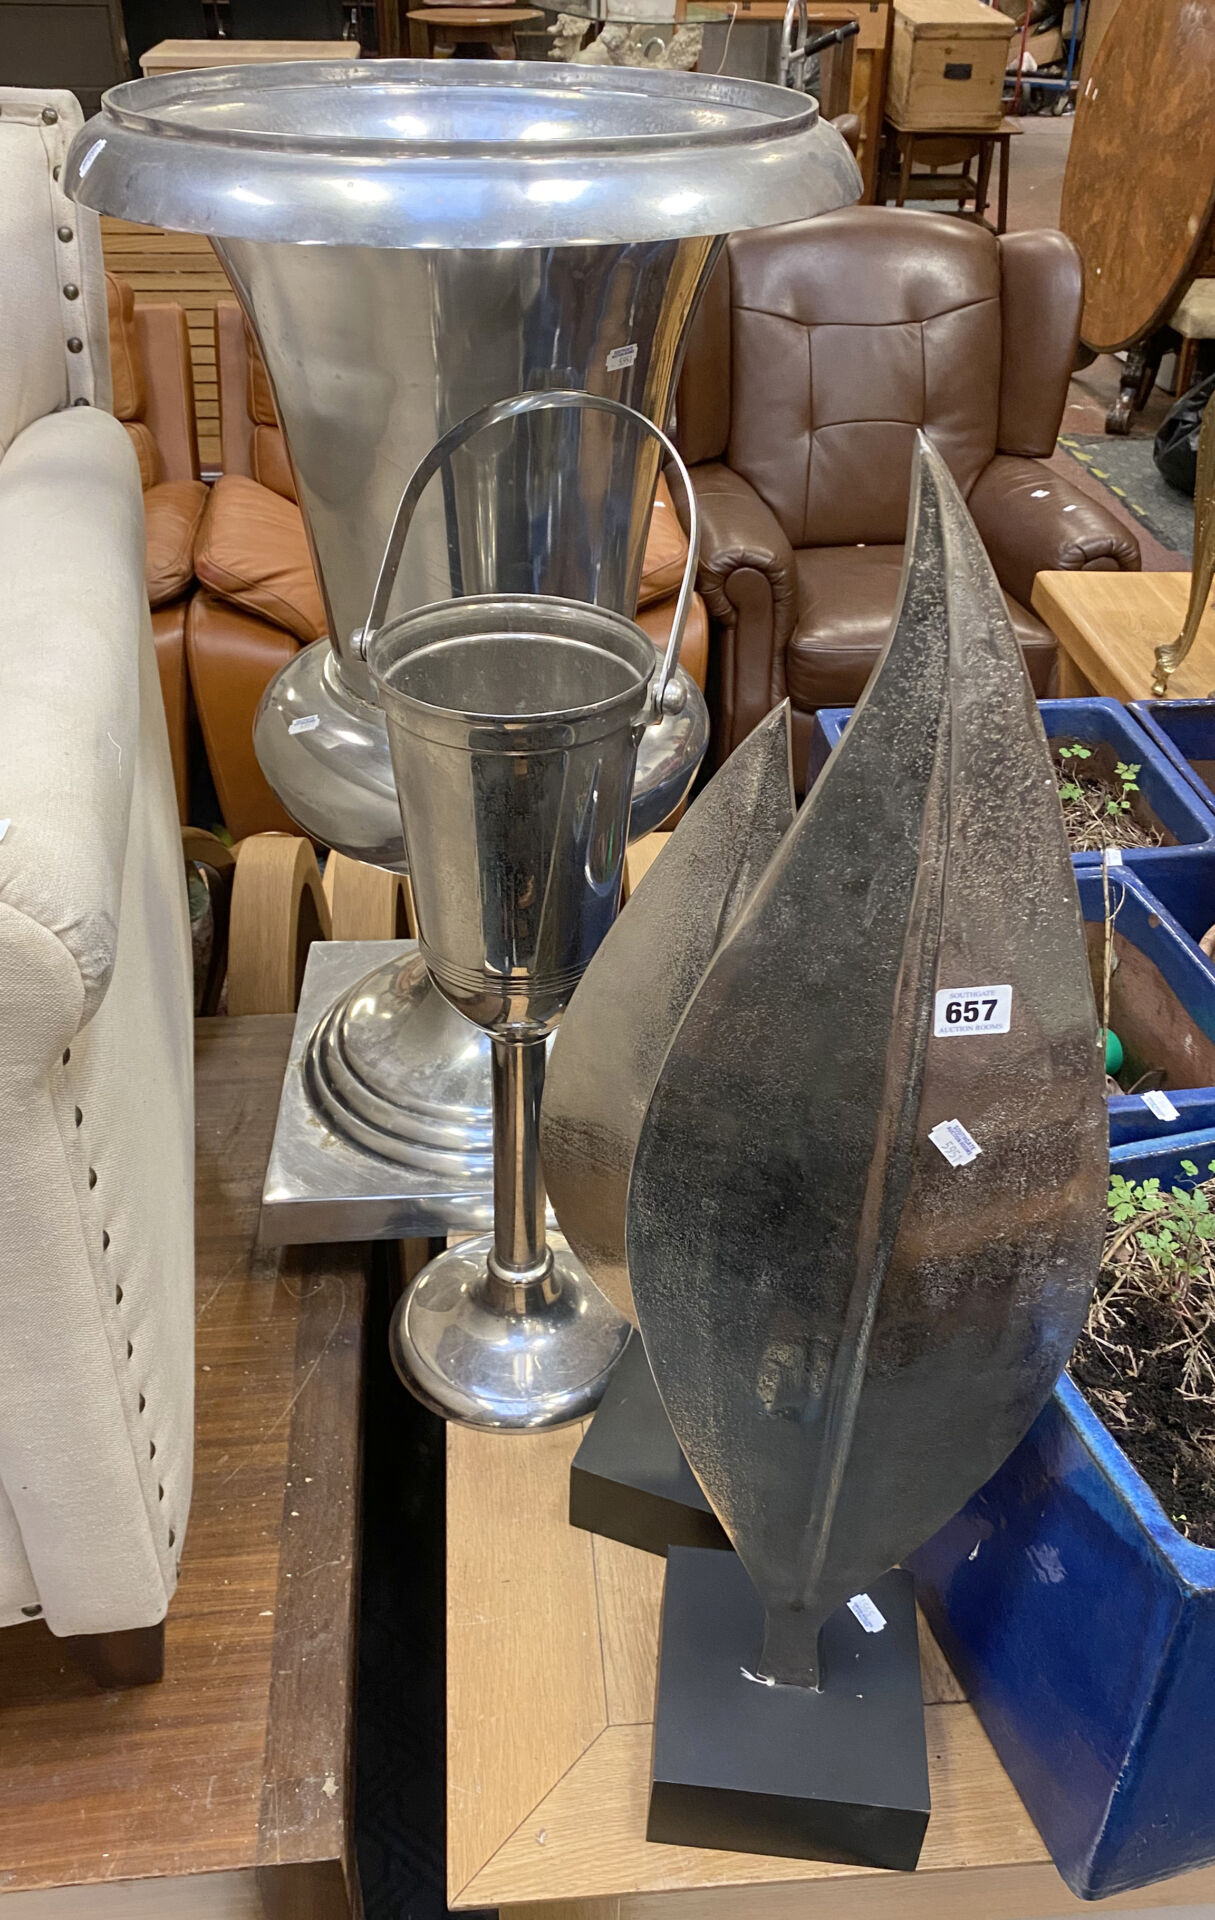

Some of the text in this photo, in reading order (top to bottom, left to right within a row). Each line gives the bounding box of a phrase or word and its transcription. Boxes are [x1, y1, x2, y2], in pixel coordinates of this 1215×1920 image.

[949, 989, 996, 999] SOUTHGATE
[945, 999, 998, 1024] 657
[939, 1023, 1004, 1034] AUCTION ROOMS
